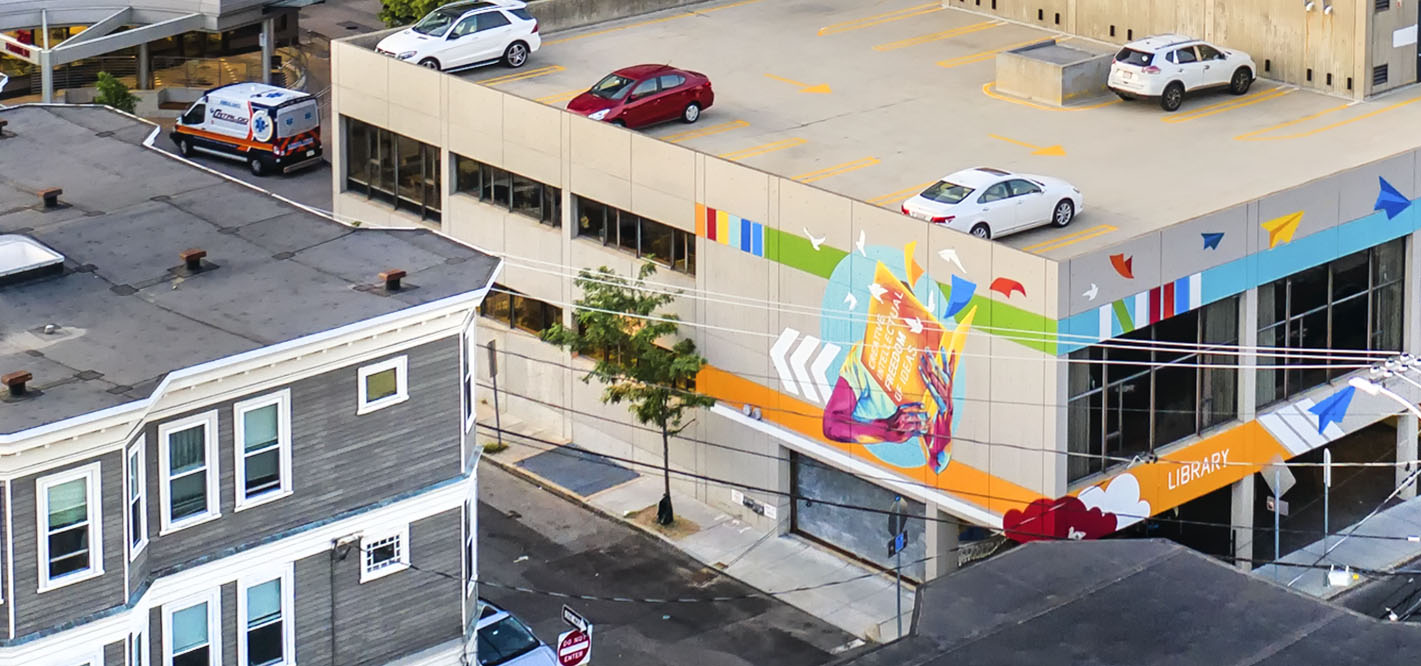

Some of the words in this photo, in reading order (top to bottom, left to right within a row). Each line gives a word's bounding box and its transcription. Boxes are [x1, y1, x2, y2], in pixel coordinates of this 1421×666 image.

[877, 291, 904, 381] INTELLECTUAL
[884, 330, 907, 392] FREEDOM
[894, 384, 904, 402] OF
[900, 345, 918, 385] IDEAS
[1168, 448, 1230, 490] LIBRARY
